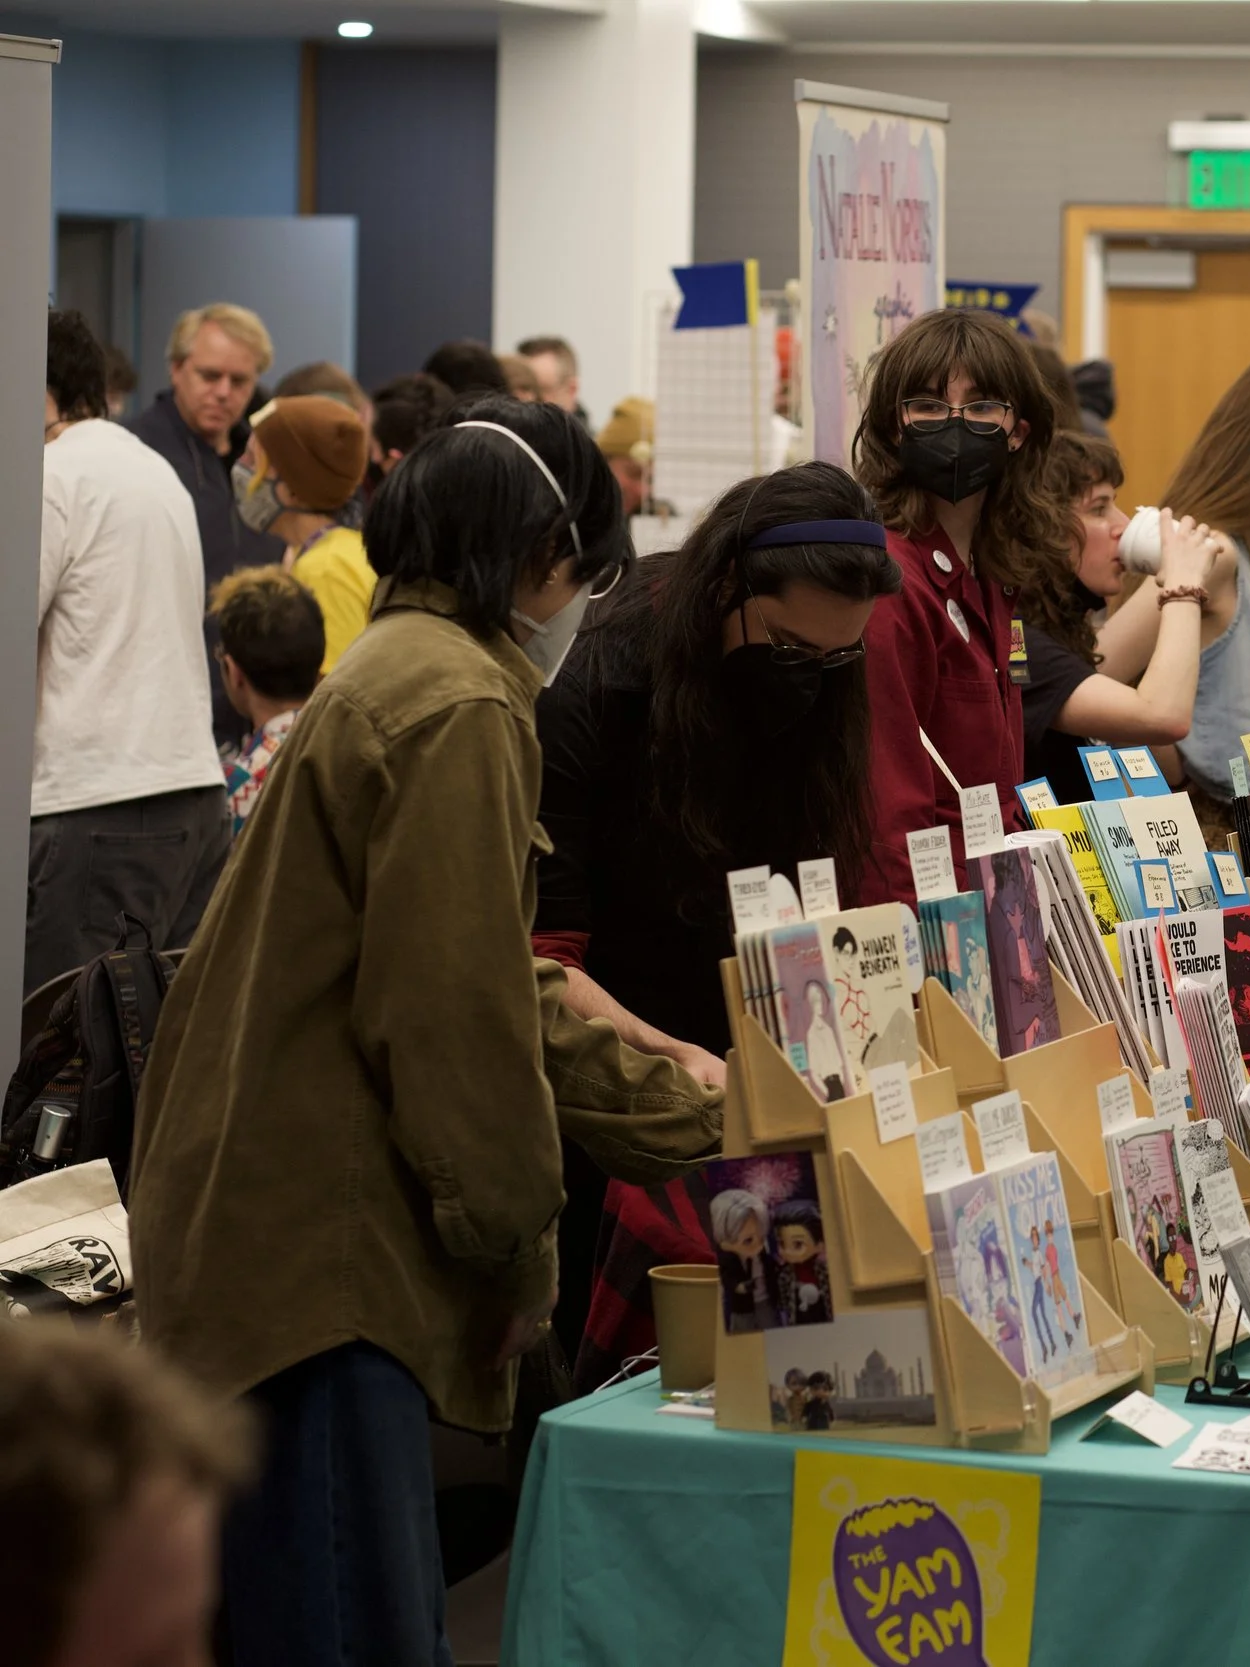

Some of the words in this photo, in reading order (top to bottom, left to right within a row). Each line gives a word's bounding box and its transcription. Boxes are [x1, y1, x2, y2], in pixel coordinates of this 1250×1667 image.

[1146, 819, 1179, 839] FILED
[1156, 838, 1183, 858] AWAY
[1182, 939, 1197, 956] TO
[859, 955, 900, 979] BENEATH
[1174, 954, 1222, 976] PERIENCE
[1002, 1168, 1036, 1206] KISS
[1034, 1156, 1057, 1195] ME
[847, 1544, 887, 1570] THE
[853, 1547, 963, 1620] YAM
[875, 1599, 973, 1666] FAM
